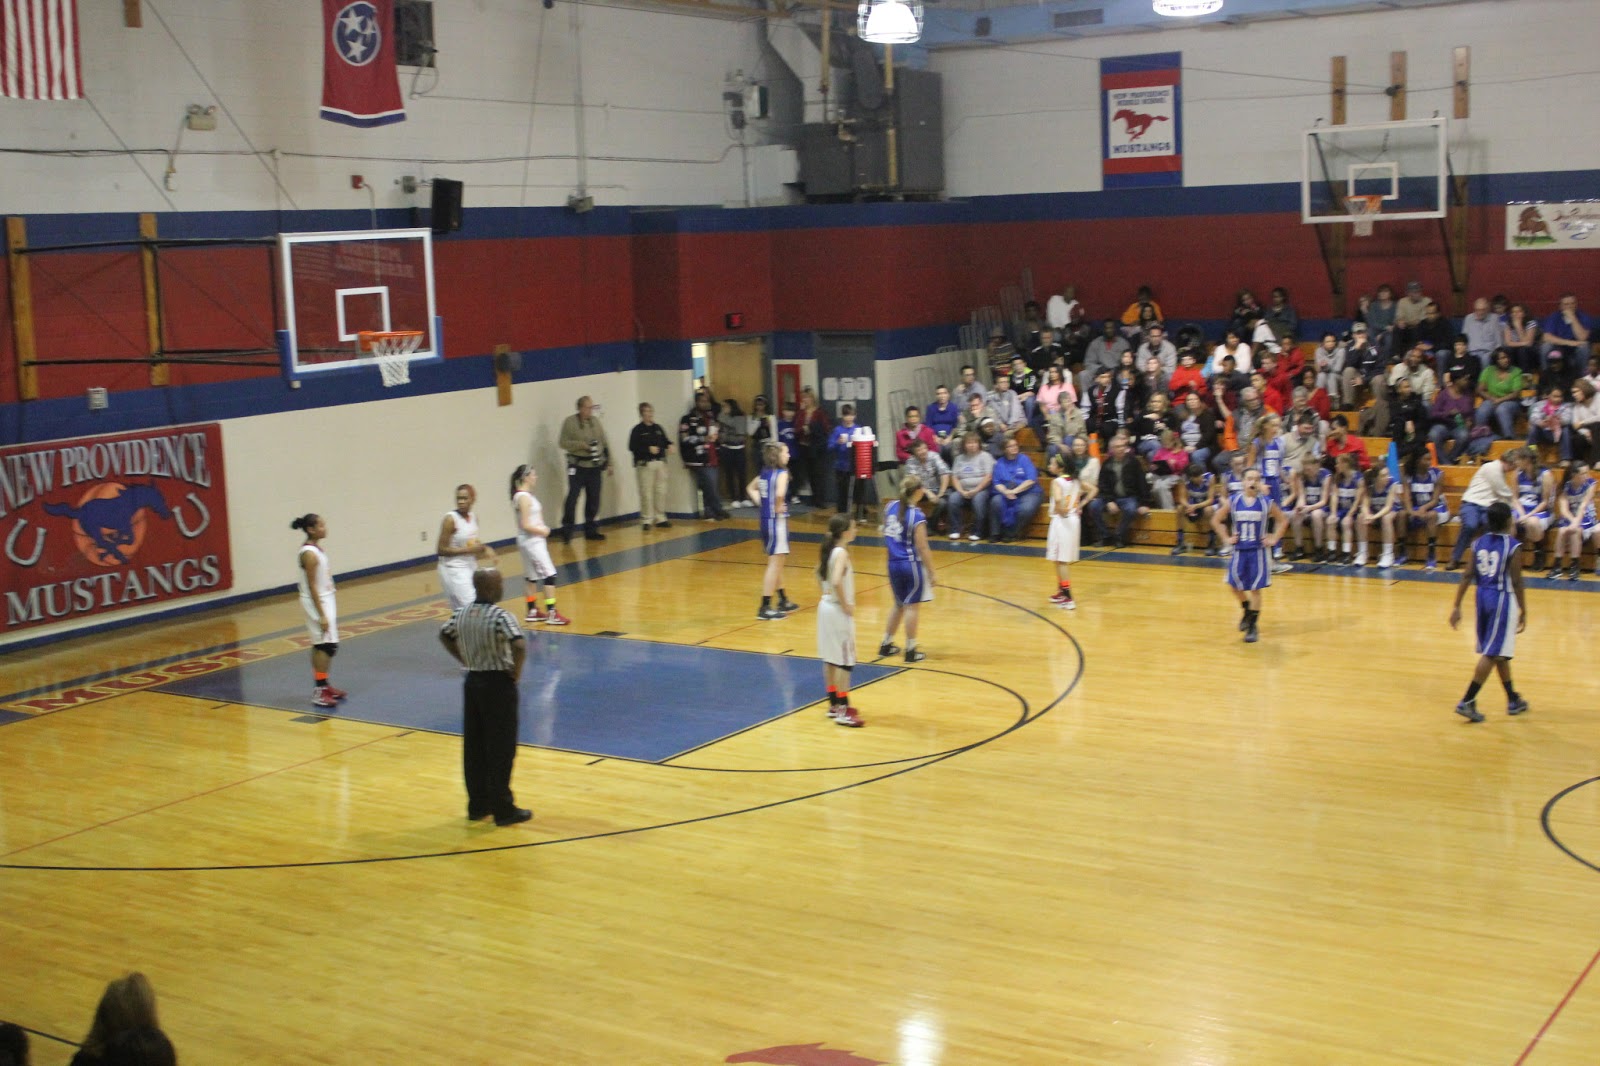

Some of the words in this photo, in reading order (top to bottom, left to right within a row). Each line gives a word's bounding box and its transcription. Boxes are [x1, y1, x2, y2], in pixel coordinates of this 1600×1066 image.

[1113, 142, 1170, 153] MUSTANGS
[0, 450, 55, 519] NEW
[59, 432, 211, 488] PROVIDENCE
[4, 555, 221, 626] MUSTANGS
